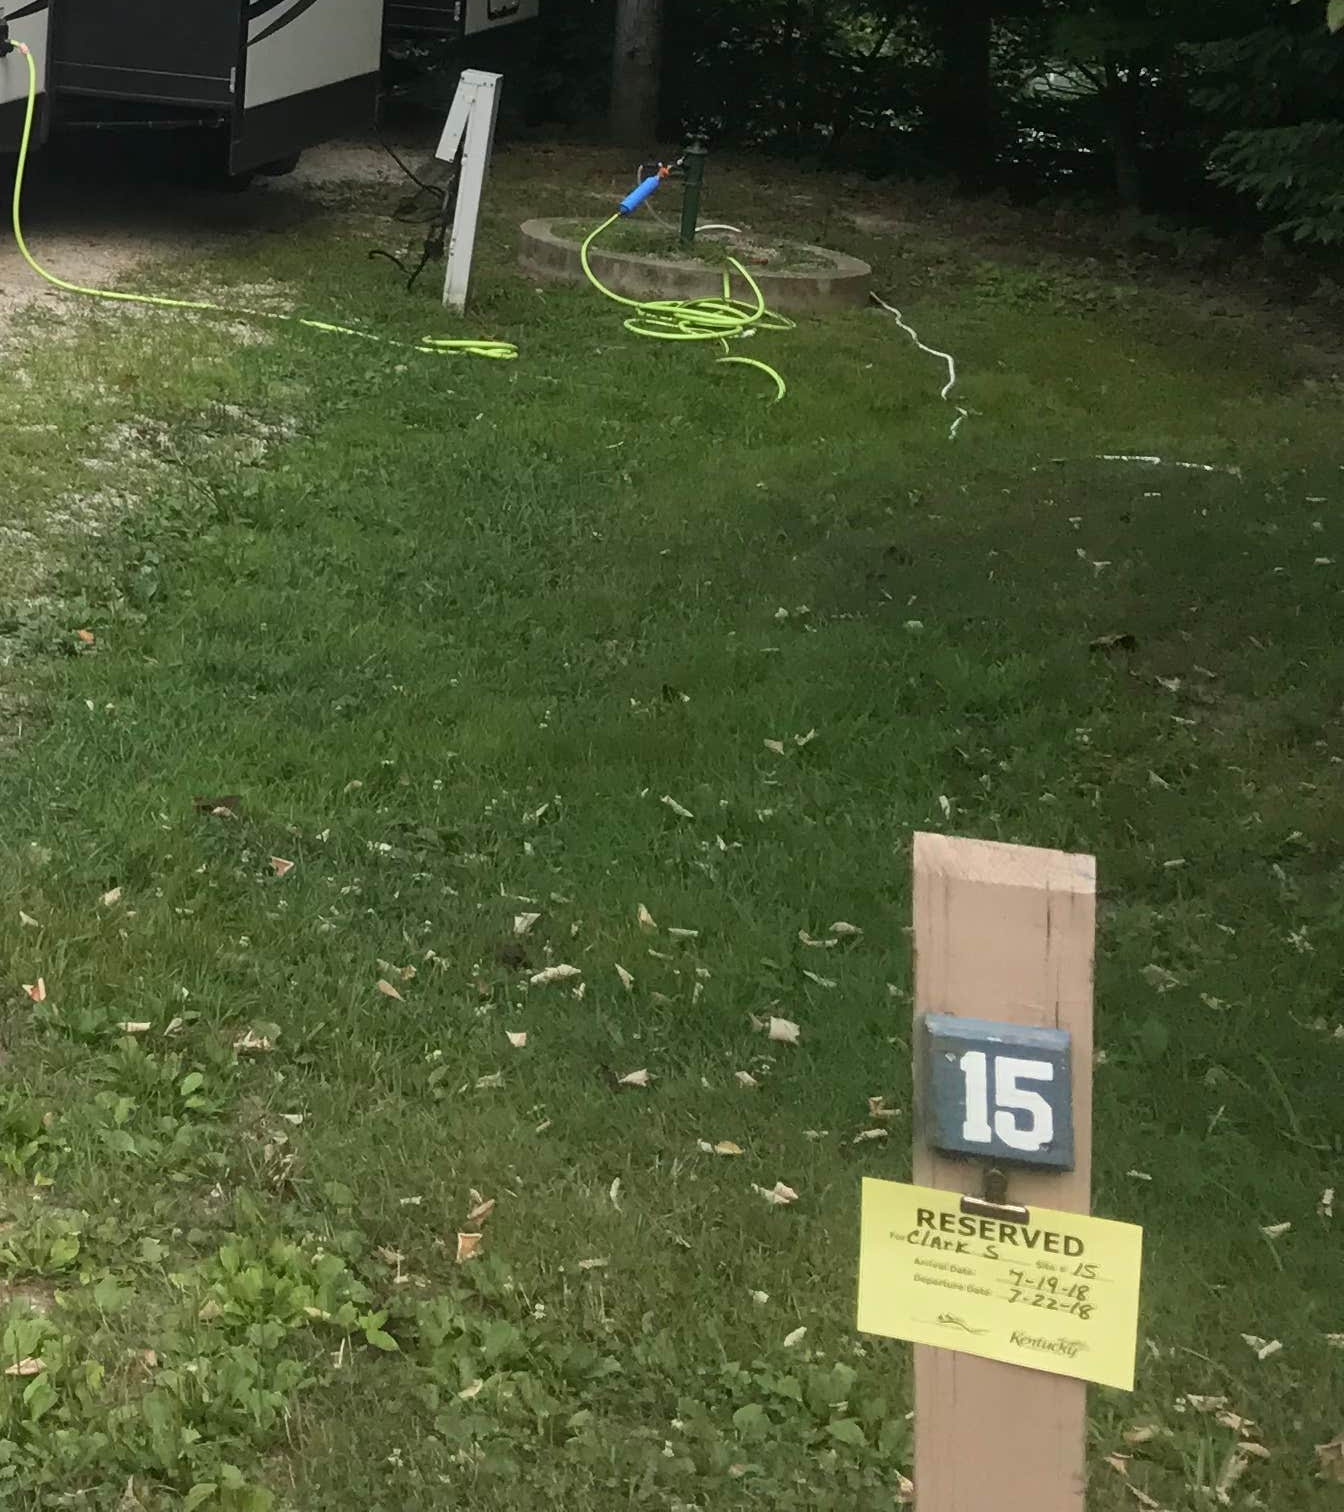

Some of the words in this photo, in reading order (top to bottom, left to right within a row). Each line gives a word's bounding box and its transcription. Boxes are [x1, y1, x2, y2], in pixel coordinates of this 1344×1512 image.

[960, 1051, 1054, 1151] 15
[916, 1207, 1085, 1257] RESERVED
[983, 1245, 999, 1260] S
[1073, 1262, 1098, 1279] 15
[1009, 1269, 1089, 1301] 7-19-18
[1008, 1288, 1096, 1320] 7-22-18
[1009, 1330, 1079, 1358] Kentucky
